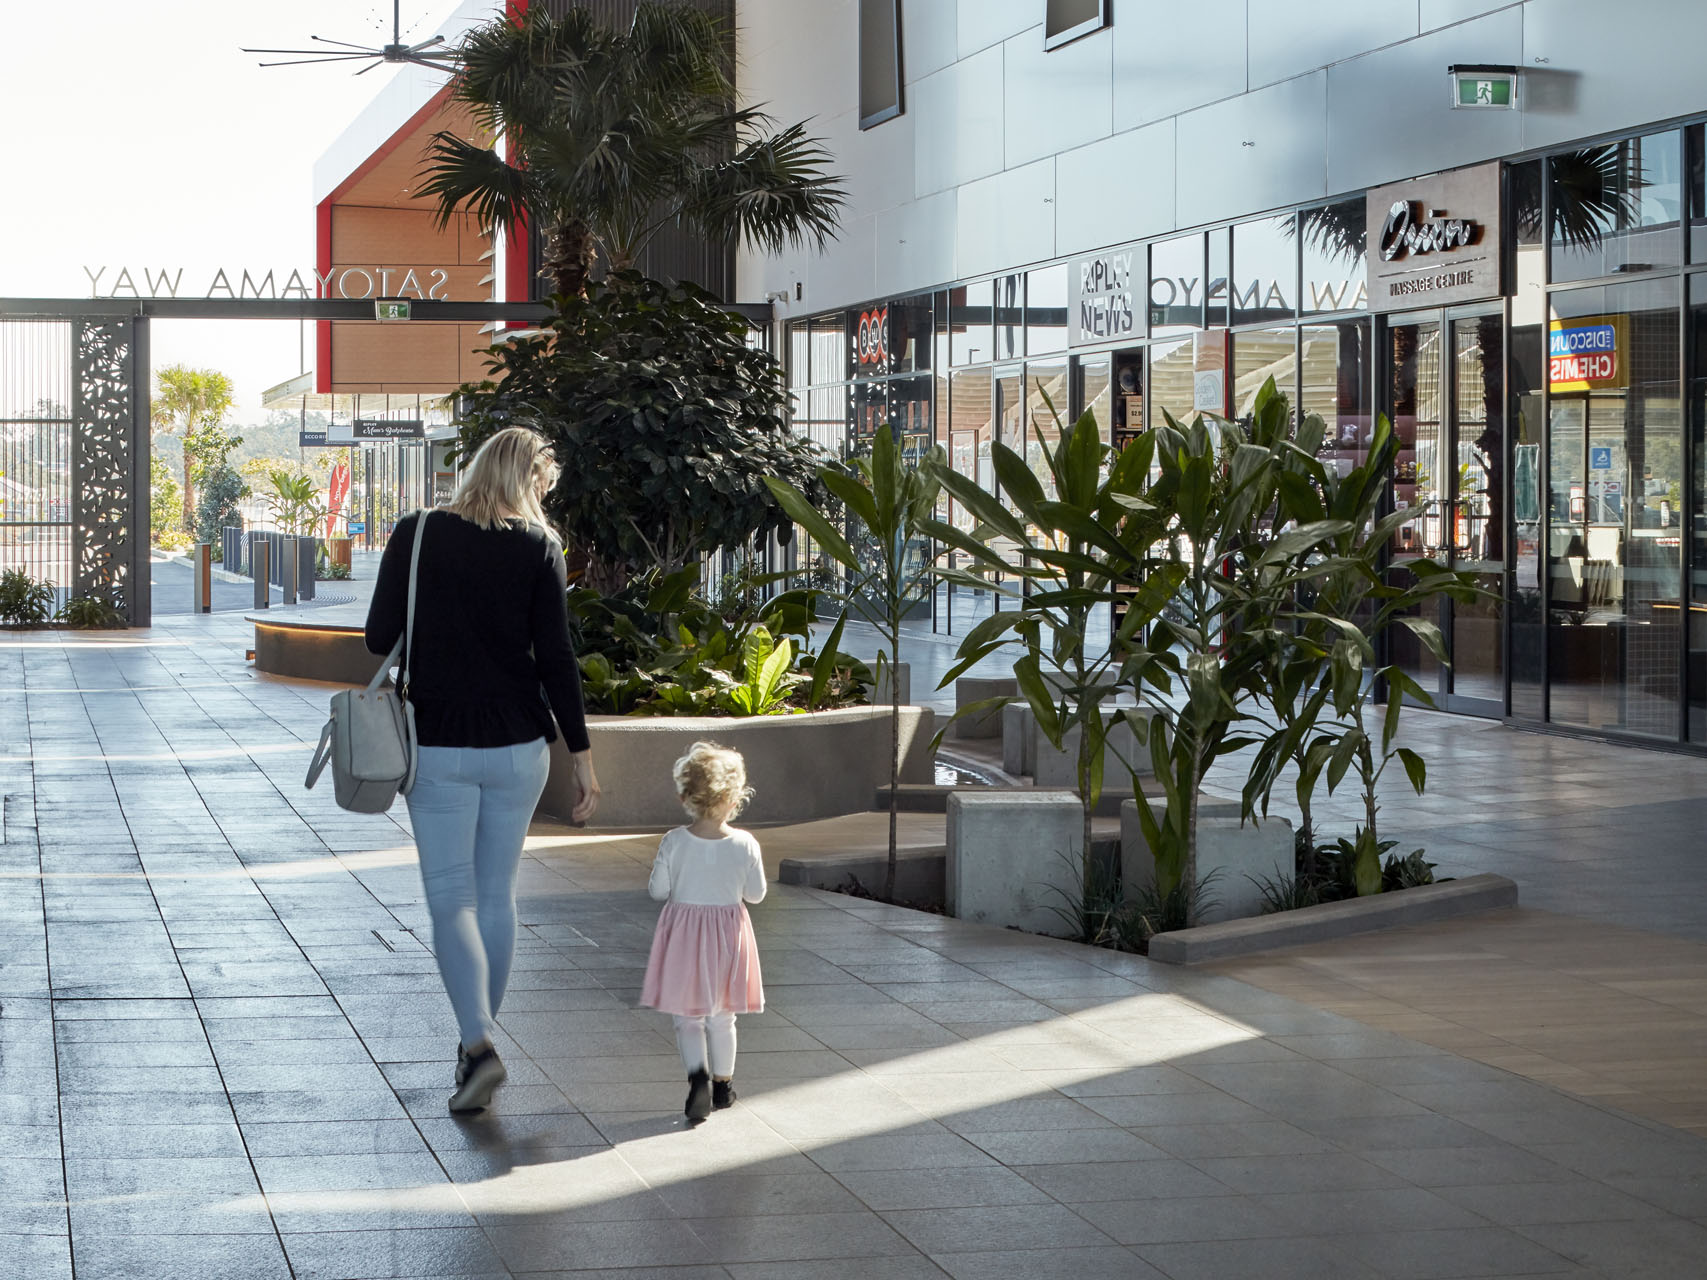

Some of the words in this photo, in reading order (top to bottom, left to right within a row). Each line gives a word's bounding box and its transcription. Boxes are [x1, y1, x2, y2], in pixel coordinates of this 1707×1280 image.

[1081, 252, 1132, 295] RIPLEY
[1390, 276, 1433, 296] MASSAGE
[1434, 269, 1474, 289] CENTRE
[1311, 279, 1368, 310] WA
[1081, 291, 1133, 340] NEWS
